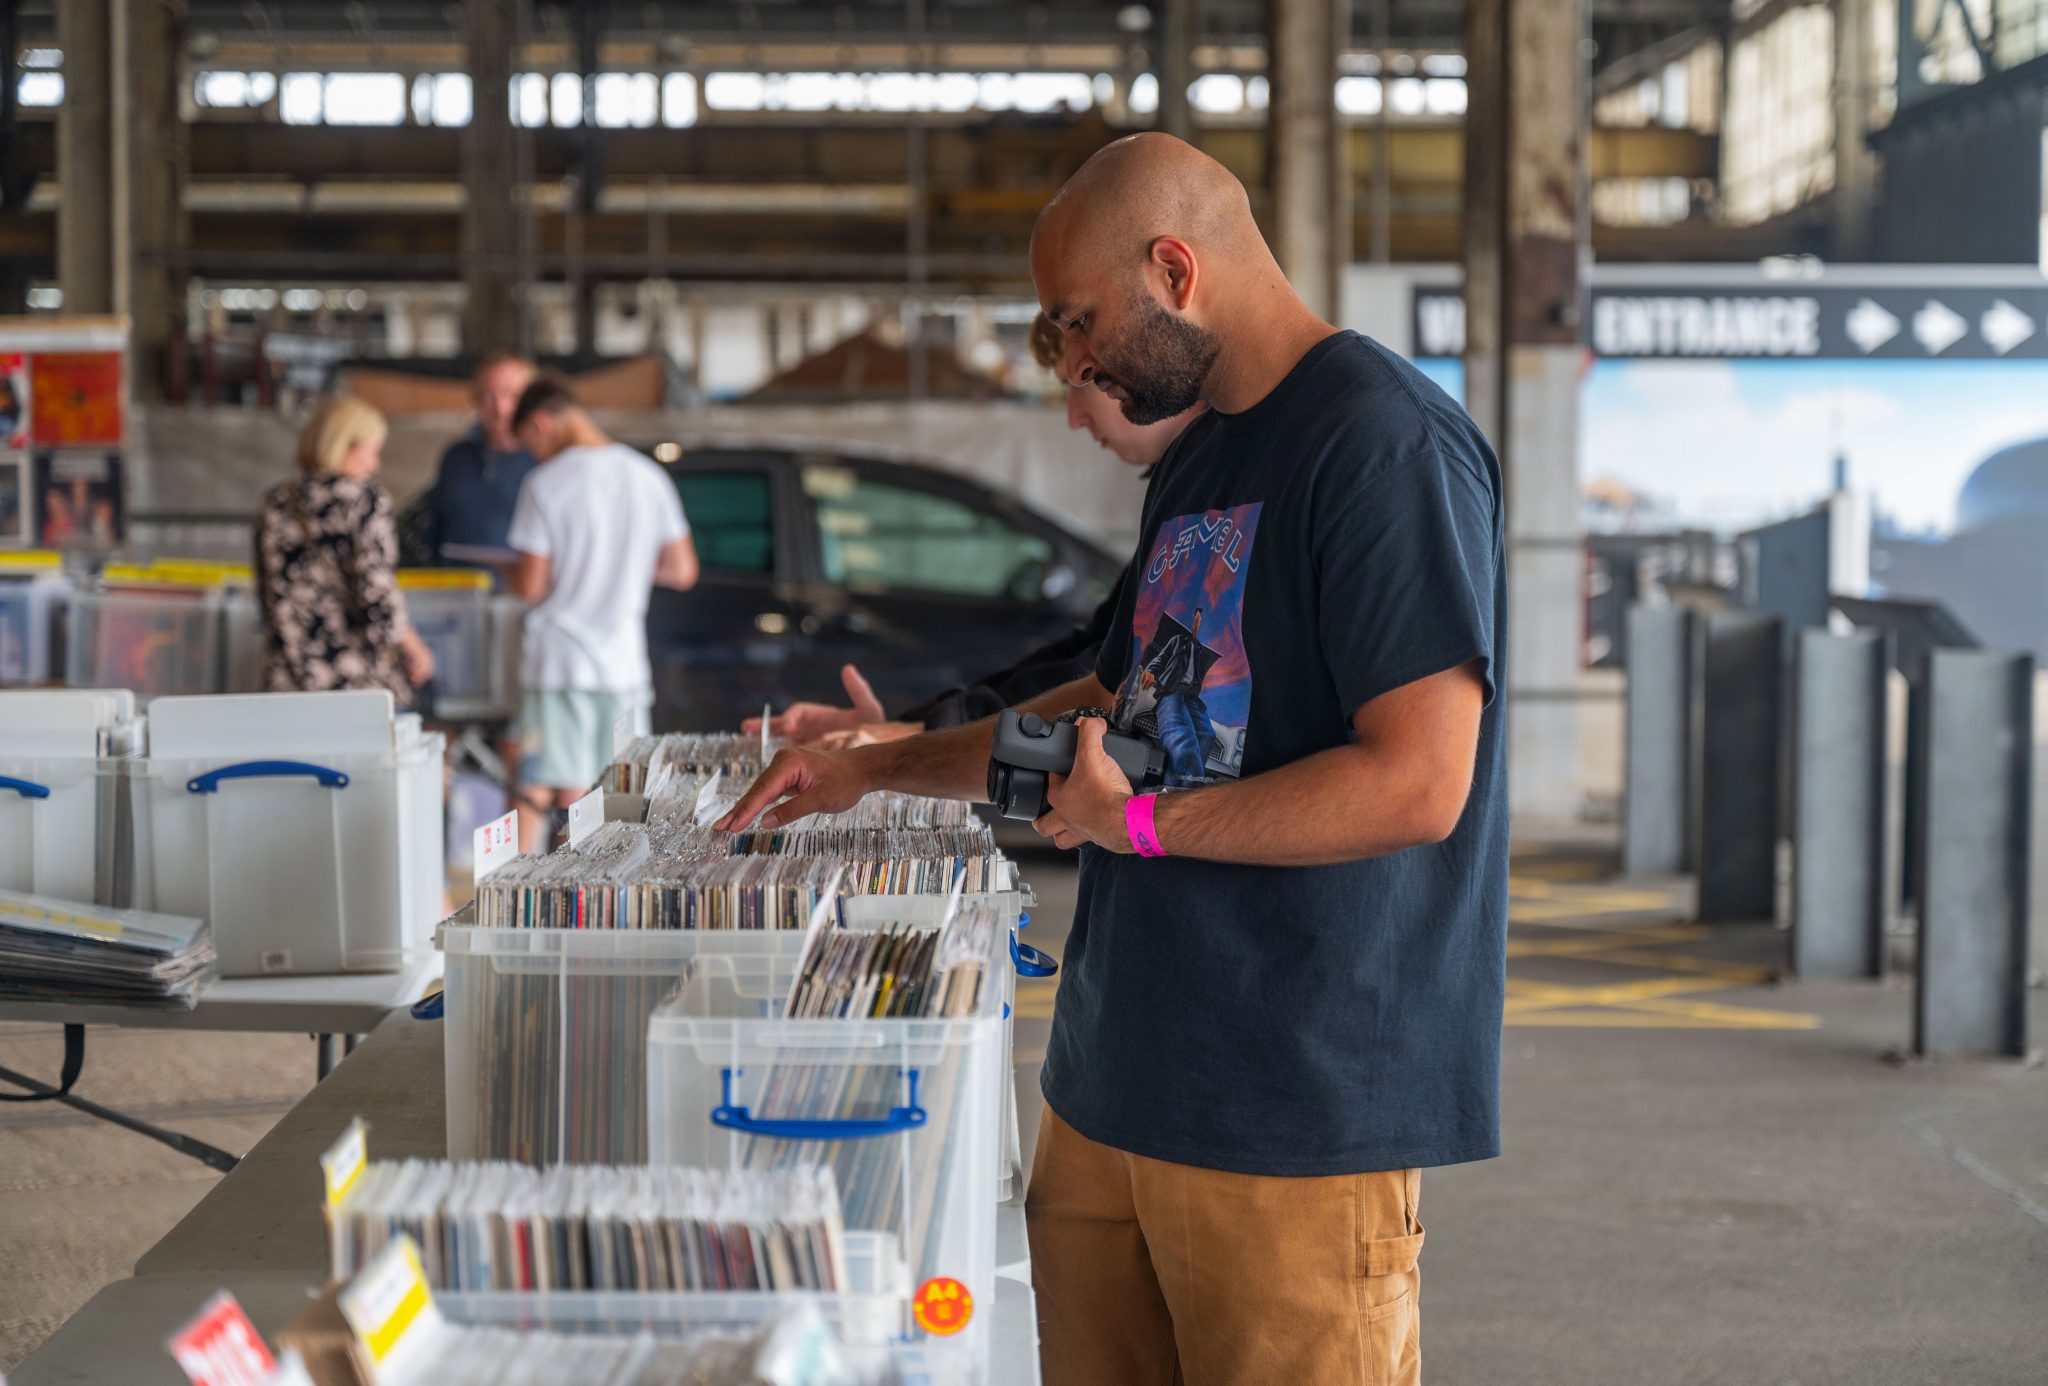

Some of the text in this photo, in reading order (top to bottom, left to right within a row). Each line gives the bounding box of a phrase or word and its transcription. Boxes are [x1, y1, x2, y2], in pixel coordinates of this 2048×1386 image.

[1593, 296, 1820, 355] ENTRANCE
[1148, 516, 1243, 584] CAMEL
[926, 1281, 960, 1303] A4
